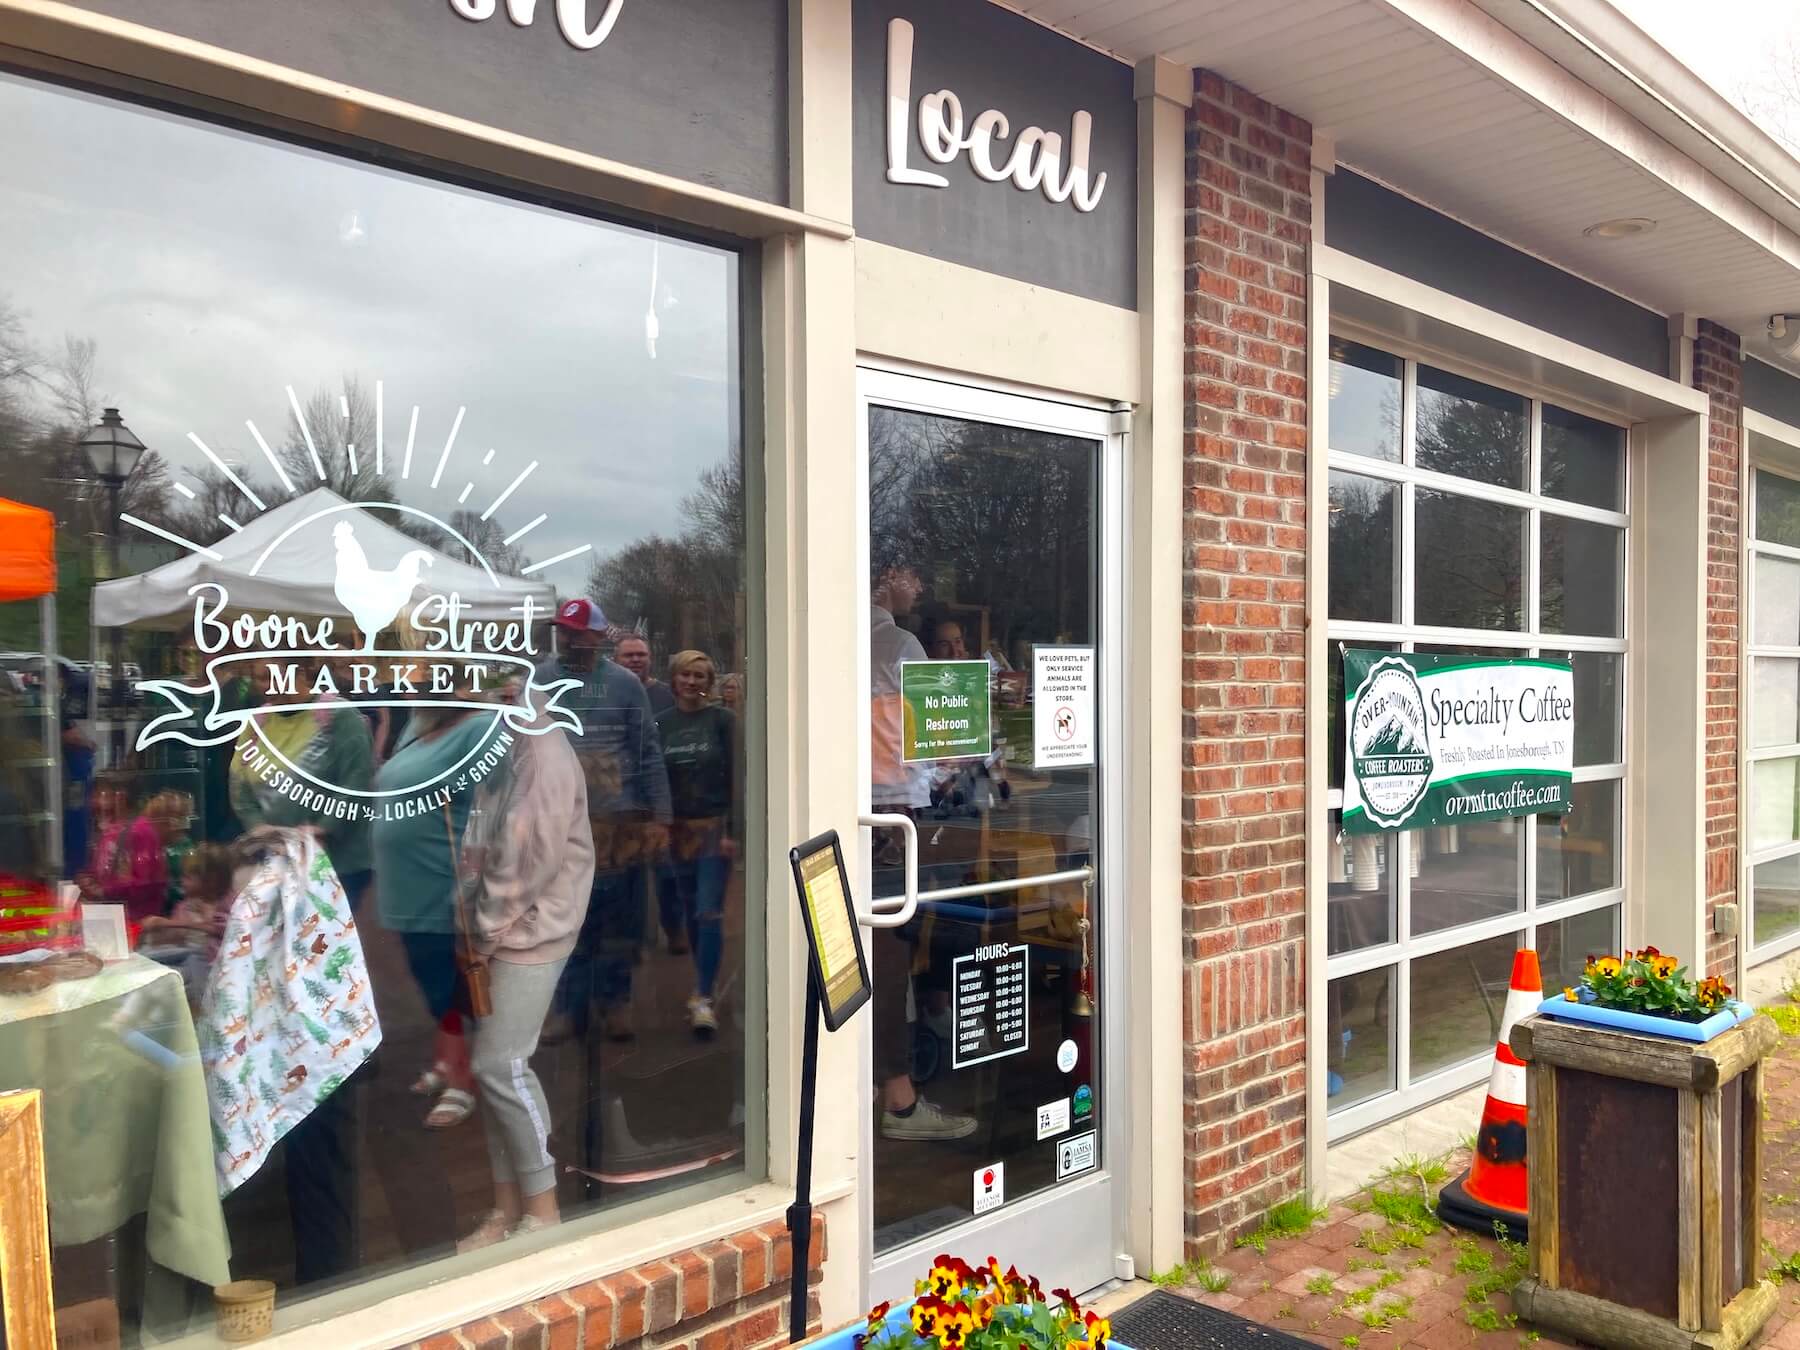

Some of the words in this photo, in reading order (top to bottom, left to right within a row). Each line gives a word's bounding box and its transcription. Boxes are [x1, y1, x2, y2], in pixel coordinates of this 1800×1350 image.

[886, 17, 1108, 213] Local
[188, 582, 339, 656] Boone
[411, 591, 539, 656] Street
[264, 663, 489, 696] MARKET
[925, 695, 939, 710] No
[941, 694, 969, 709] Public
[1430, 686, 1514, 739] Specialty
[1519, 684, 1571, 723] Coffee
[925, 717, 969, 732] Restroom
[914, 740, 929, 749] Sorry
[937, 739, 945, 747] the
[1440, 746, 1466, 767] Freshly
[1467, 745, 1495, 761] Roasted
[1496, 744, 1505, 760] In
[1552, 740, 1566, 754] TN
[1364, 759, 1386, 775] COFFEE
[1387, 758, 1425, 774] ROASTERS
[234, 736, 359, 823] JONESBOROUGH
[383, 786, 453, 823] LOCALLY
[468, 730, 516, 785] GROWN
[975, 942, 1009, 962] HOURS
[960, 969, 981, 981] MONDAY
[960, 981, 982, 993] TUESDAY
[960, 991, 990, 1005] WEDNESDAY
[960, 1004, 986, 1017] THURSDAY
[960, 1018, 978, 1029] FRIDAY
[960, 1028, 985, 1041] SATURDAY
[960, 1041, 980, 1054] SUNDAY
[1003, 1030, 1023, 1042] CLOSED
